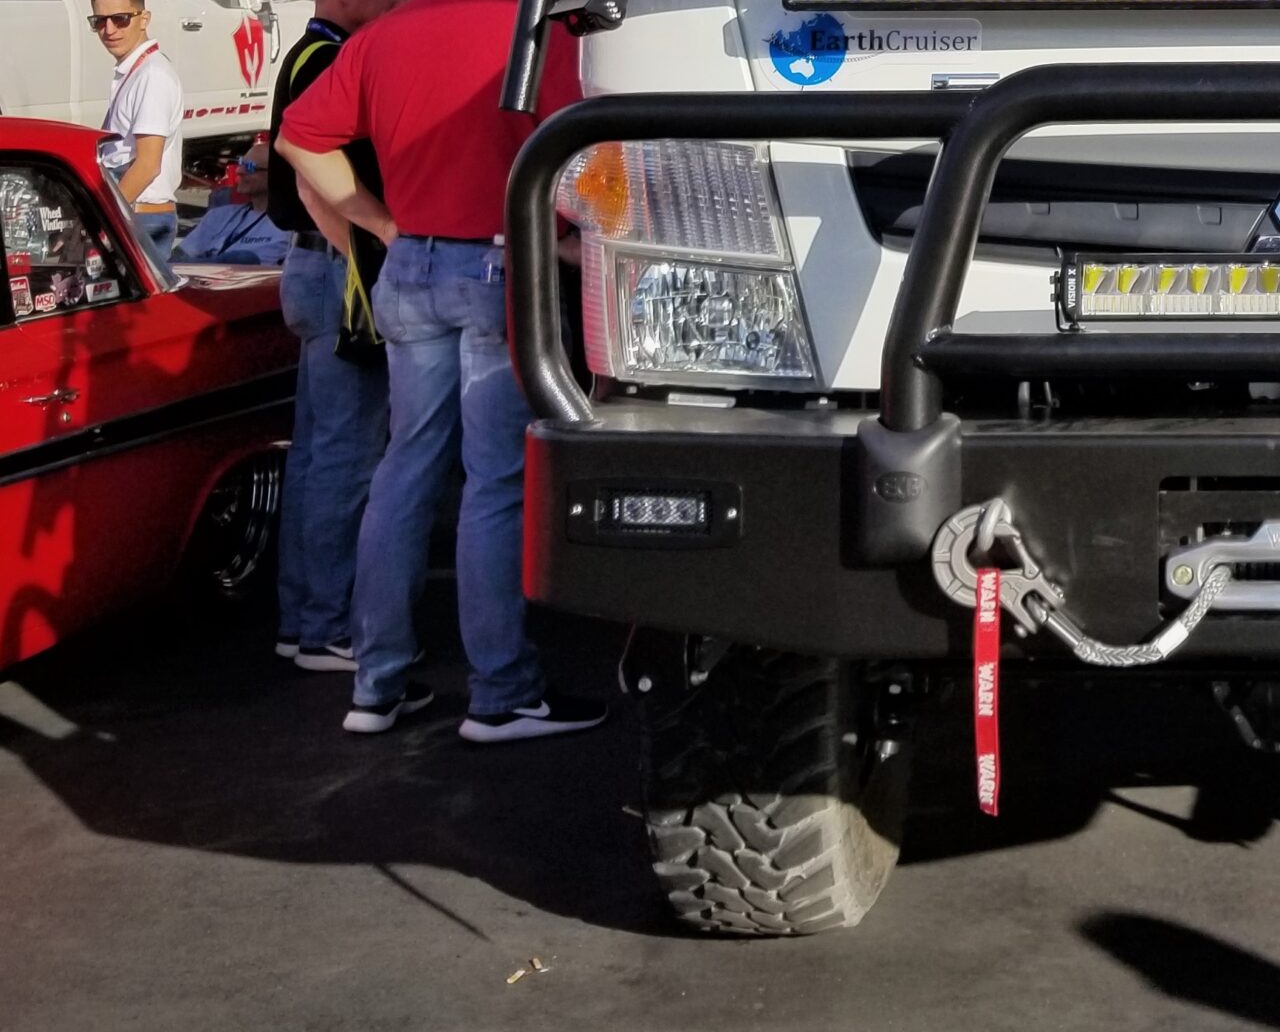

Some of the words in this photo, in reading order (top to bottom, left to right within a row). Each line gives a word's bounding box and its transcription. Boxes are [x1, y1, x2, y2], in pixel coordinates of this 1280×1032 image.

[810, 29, 978, 52] EarthCruiser
[40, 206, 62, 219] Wheel
[1067, 268, 1077, 276] X
[1067, 278, 1076, 308] VISION
[979, 571, 998, 623] WARN
[978, 663, 995, 717] WARN
[978, 753, 996, 806] WARN
